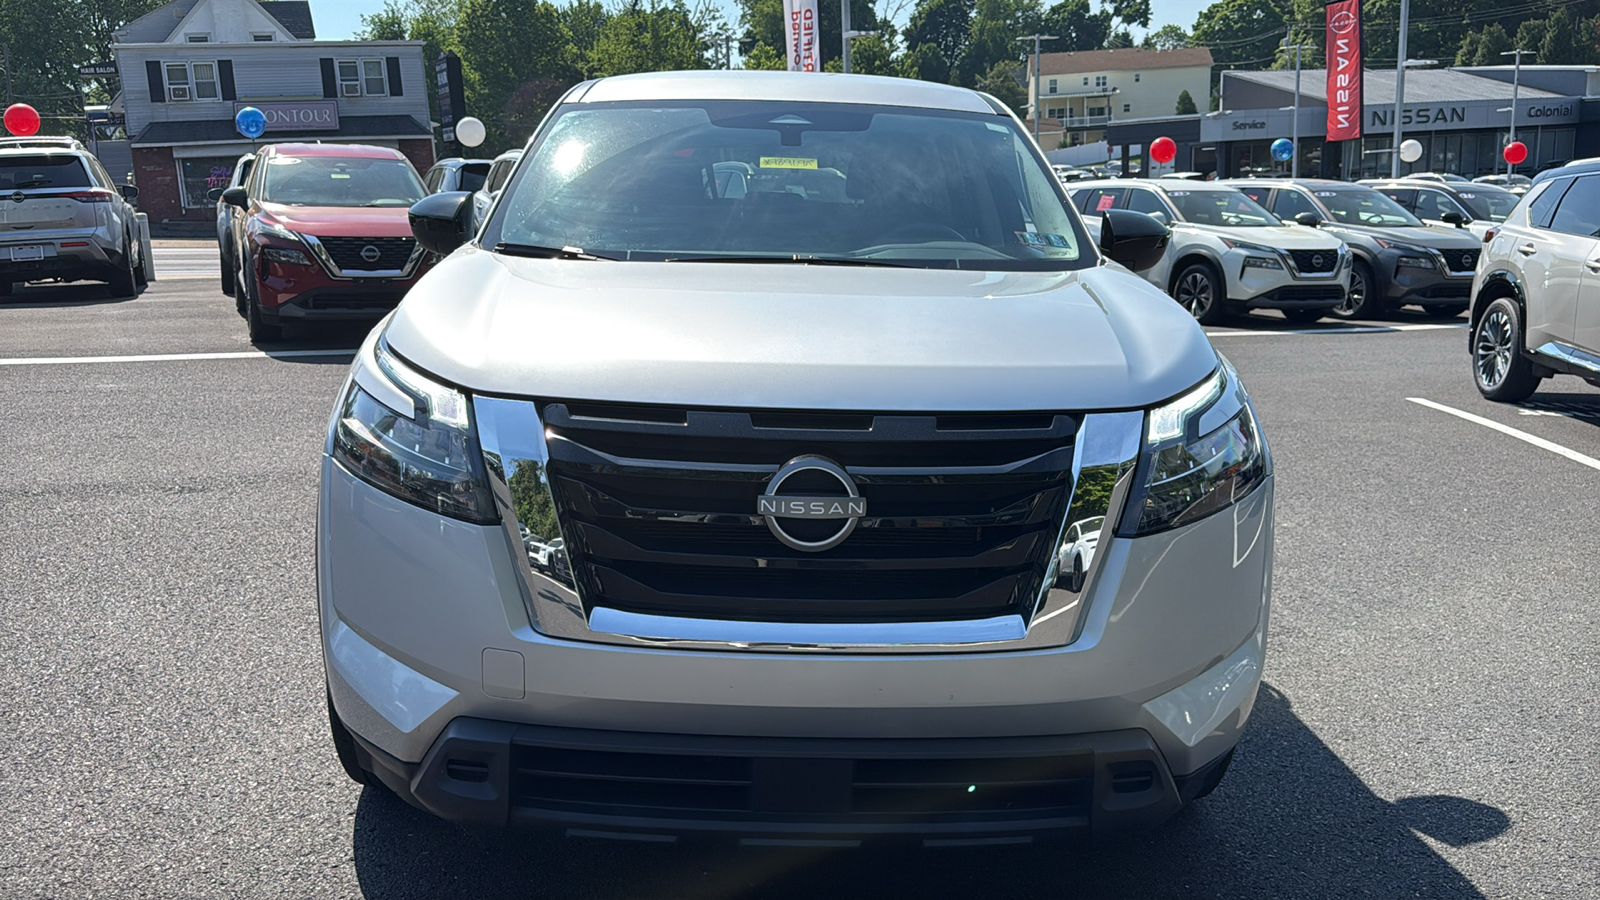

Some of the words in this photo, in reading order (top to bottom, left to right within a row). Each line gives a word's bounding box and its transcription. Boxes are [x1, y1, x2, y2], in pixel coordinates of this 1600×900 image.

[265, 109, 331, 124] ONTOUR
[1371, 107, 1466, 126] NISSAN
[1527, 104, 1573, 118] Colonial
[1231, 120, 1266, 131] Service
[760, 499, 863, 515] NISSAN
